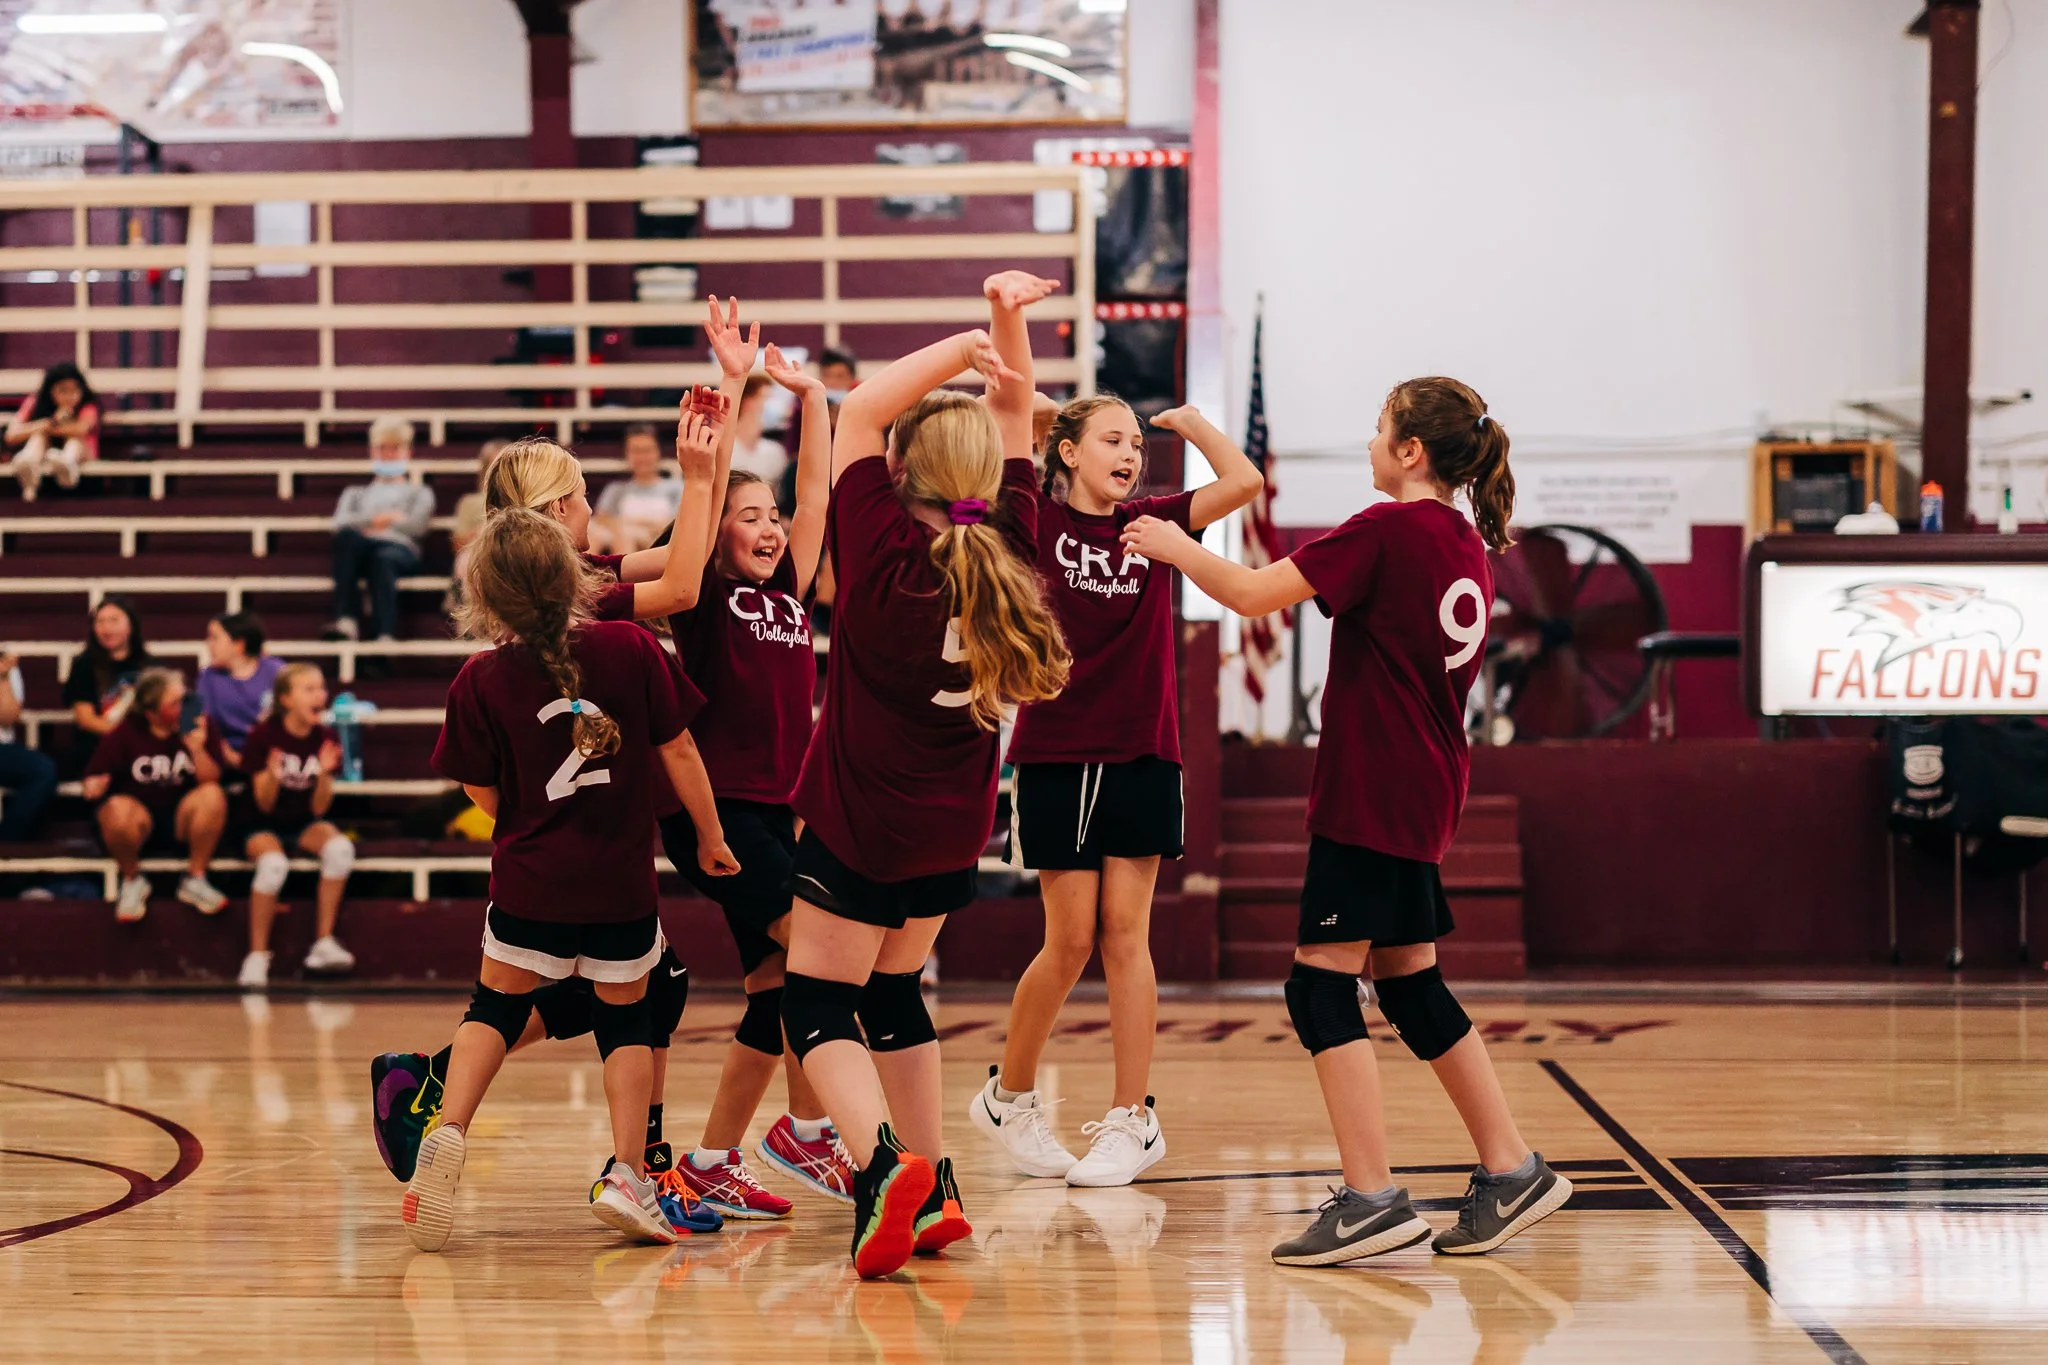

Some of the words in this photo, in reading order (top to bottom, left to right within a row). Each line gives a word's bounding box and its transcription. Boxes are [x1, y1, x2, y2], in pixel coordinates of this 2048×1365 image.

[1055, 532, 1149, 577] CRA
[1065, 569, 1139, 598] Volleyball
[1439, 578, 1486, 672] 9
[1811, 642, 2041, 698] FALCONS
[280, 752, 321, 778] RA
[537, 698, 611, 801] 2
